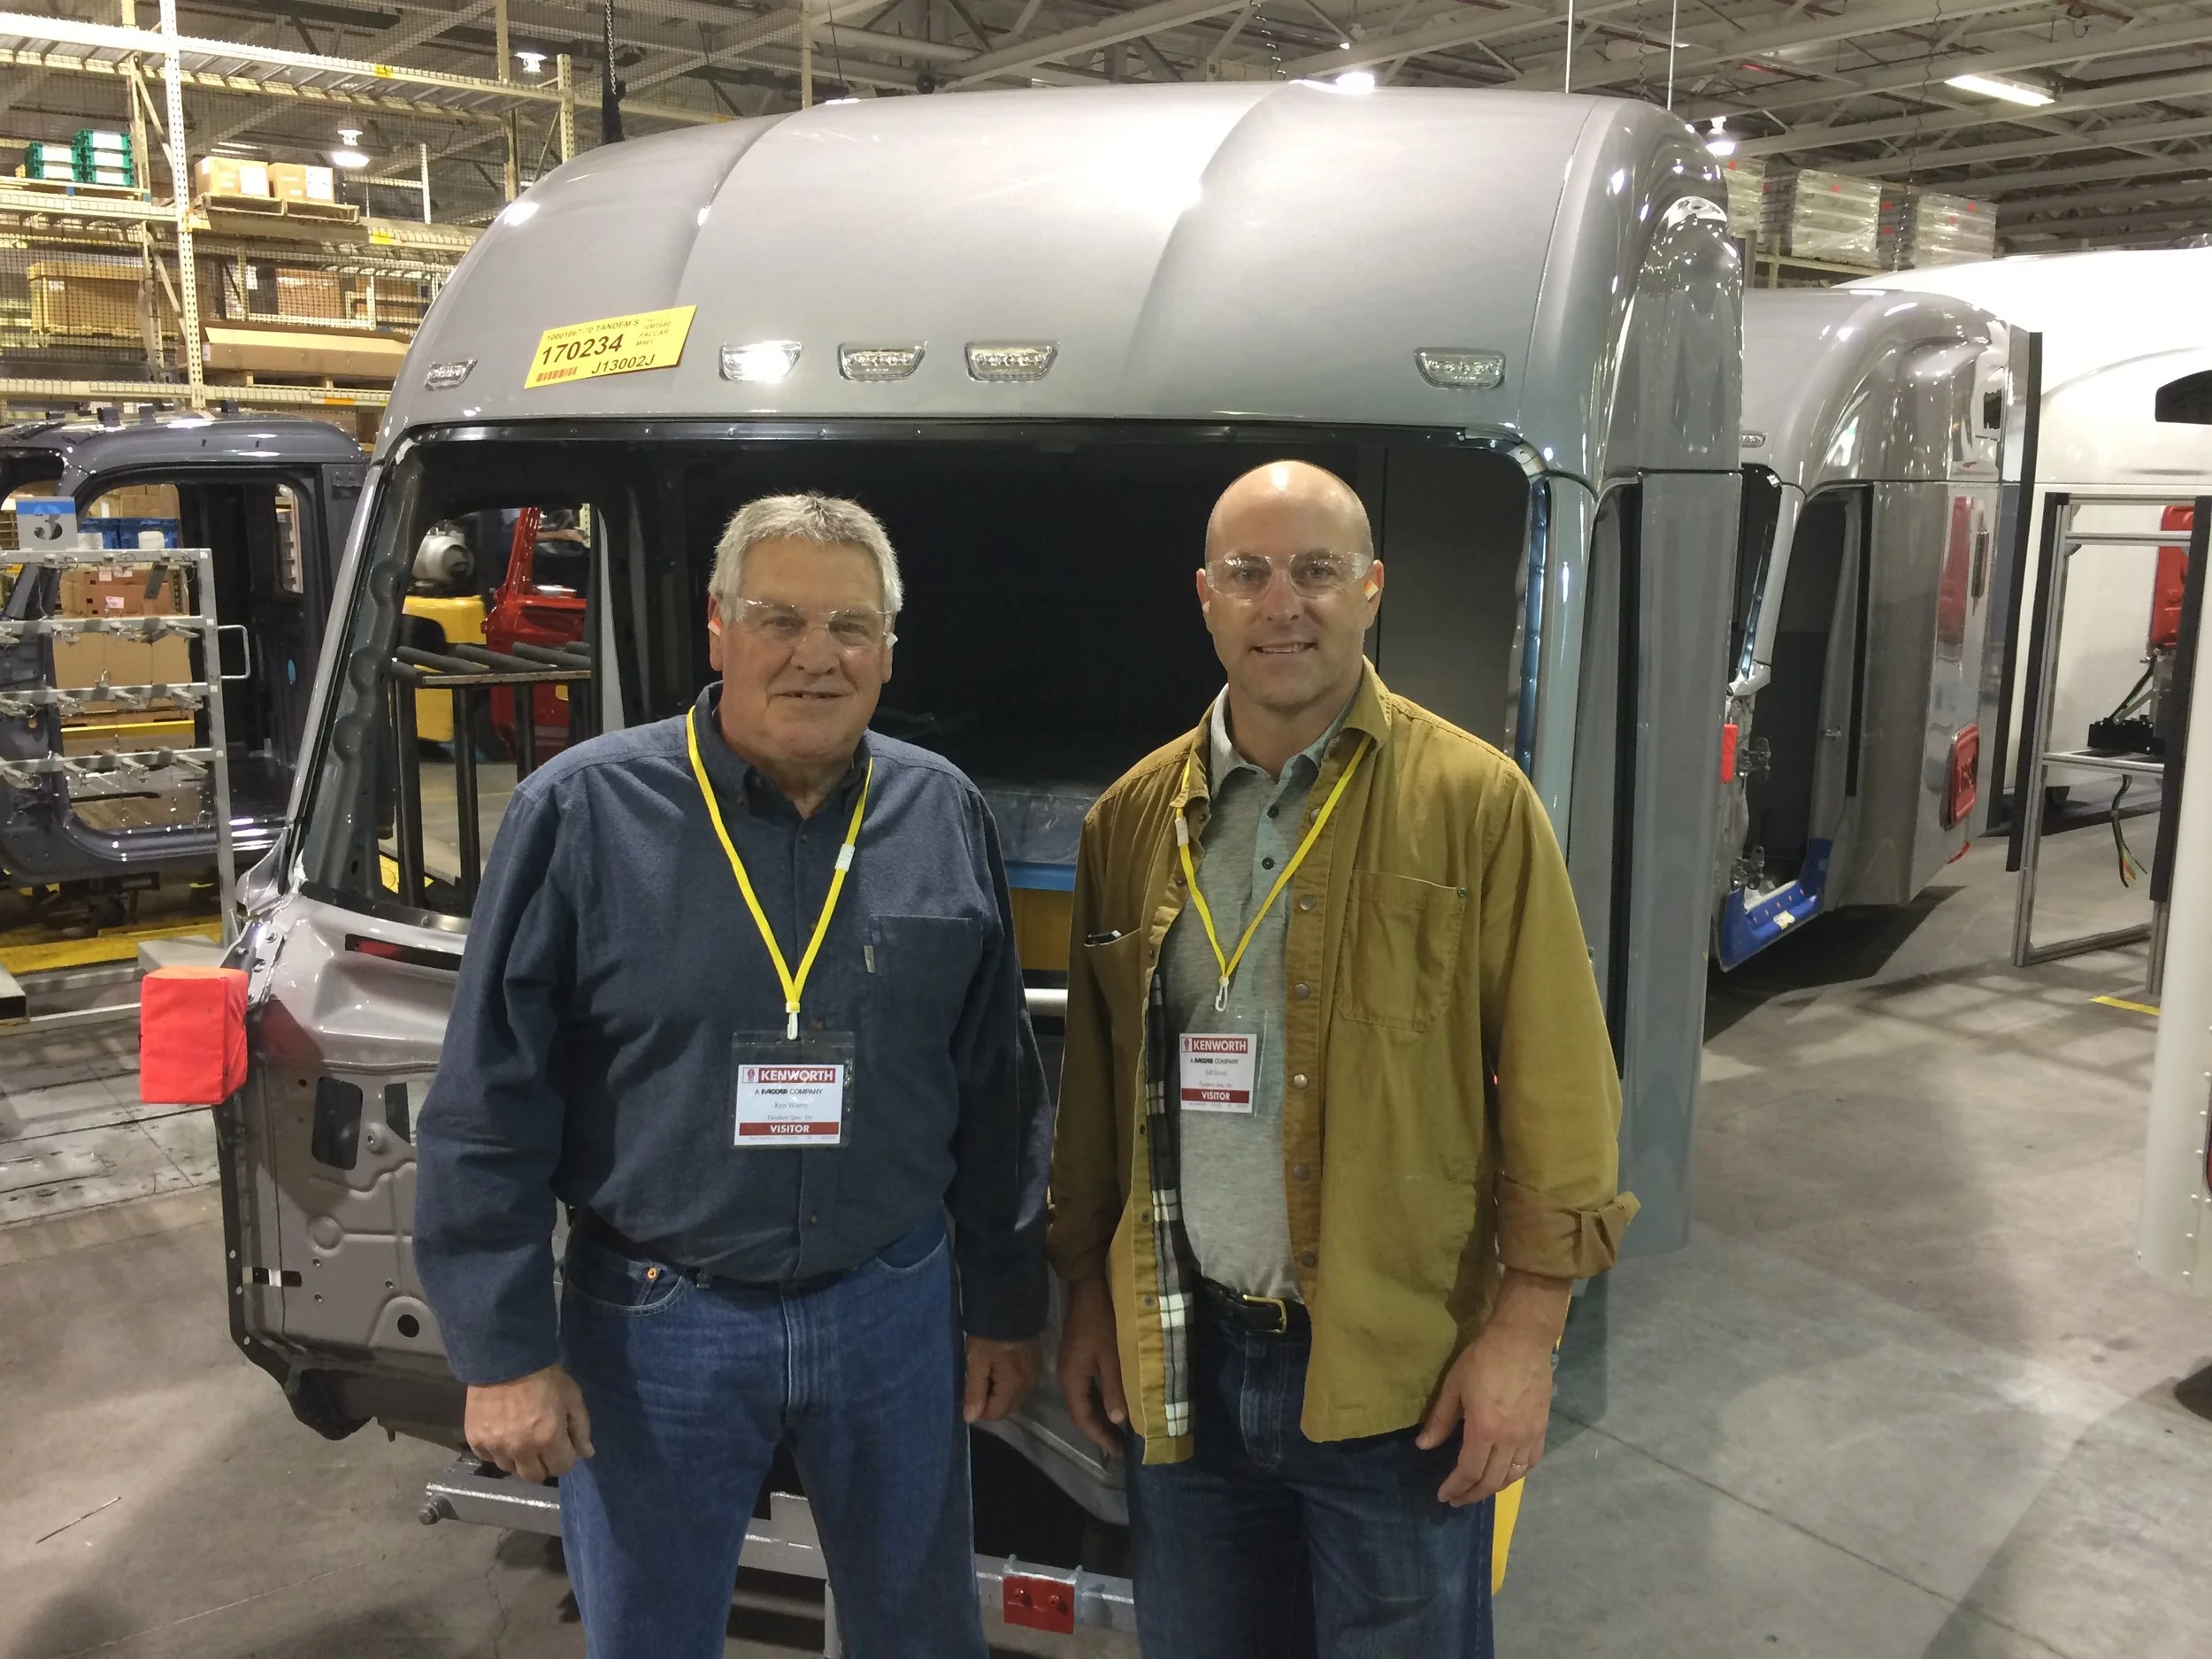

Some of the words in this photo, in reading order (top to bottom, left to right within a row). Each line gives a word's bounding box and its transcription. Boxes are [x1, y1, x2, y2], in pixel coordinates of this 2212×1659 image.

[595, 319, 632, 334] TANDEM
[541, 334, 625, 365] 170234
[591, 354, 656, 374] J13002J
[34, 504, 63, 541] 3
[1194, 1041, 1246, 1052] KENWORTH
[761, 1070, 833, 1081] KENWORTH
[1201, 1091, 1231, 1101] VISITOR
[770, 1124, 810, 1133] VISITOR
